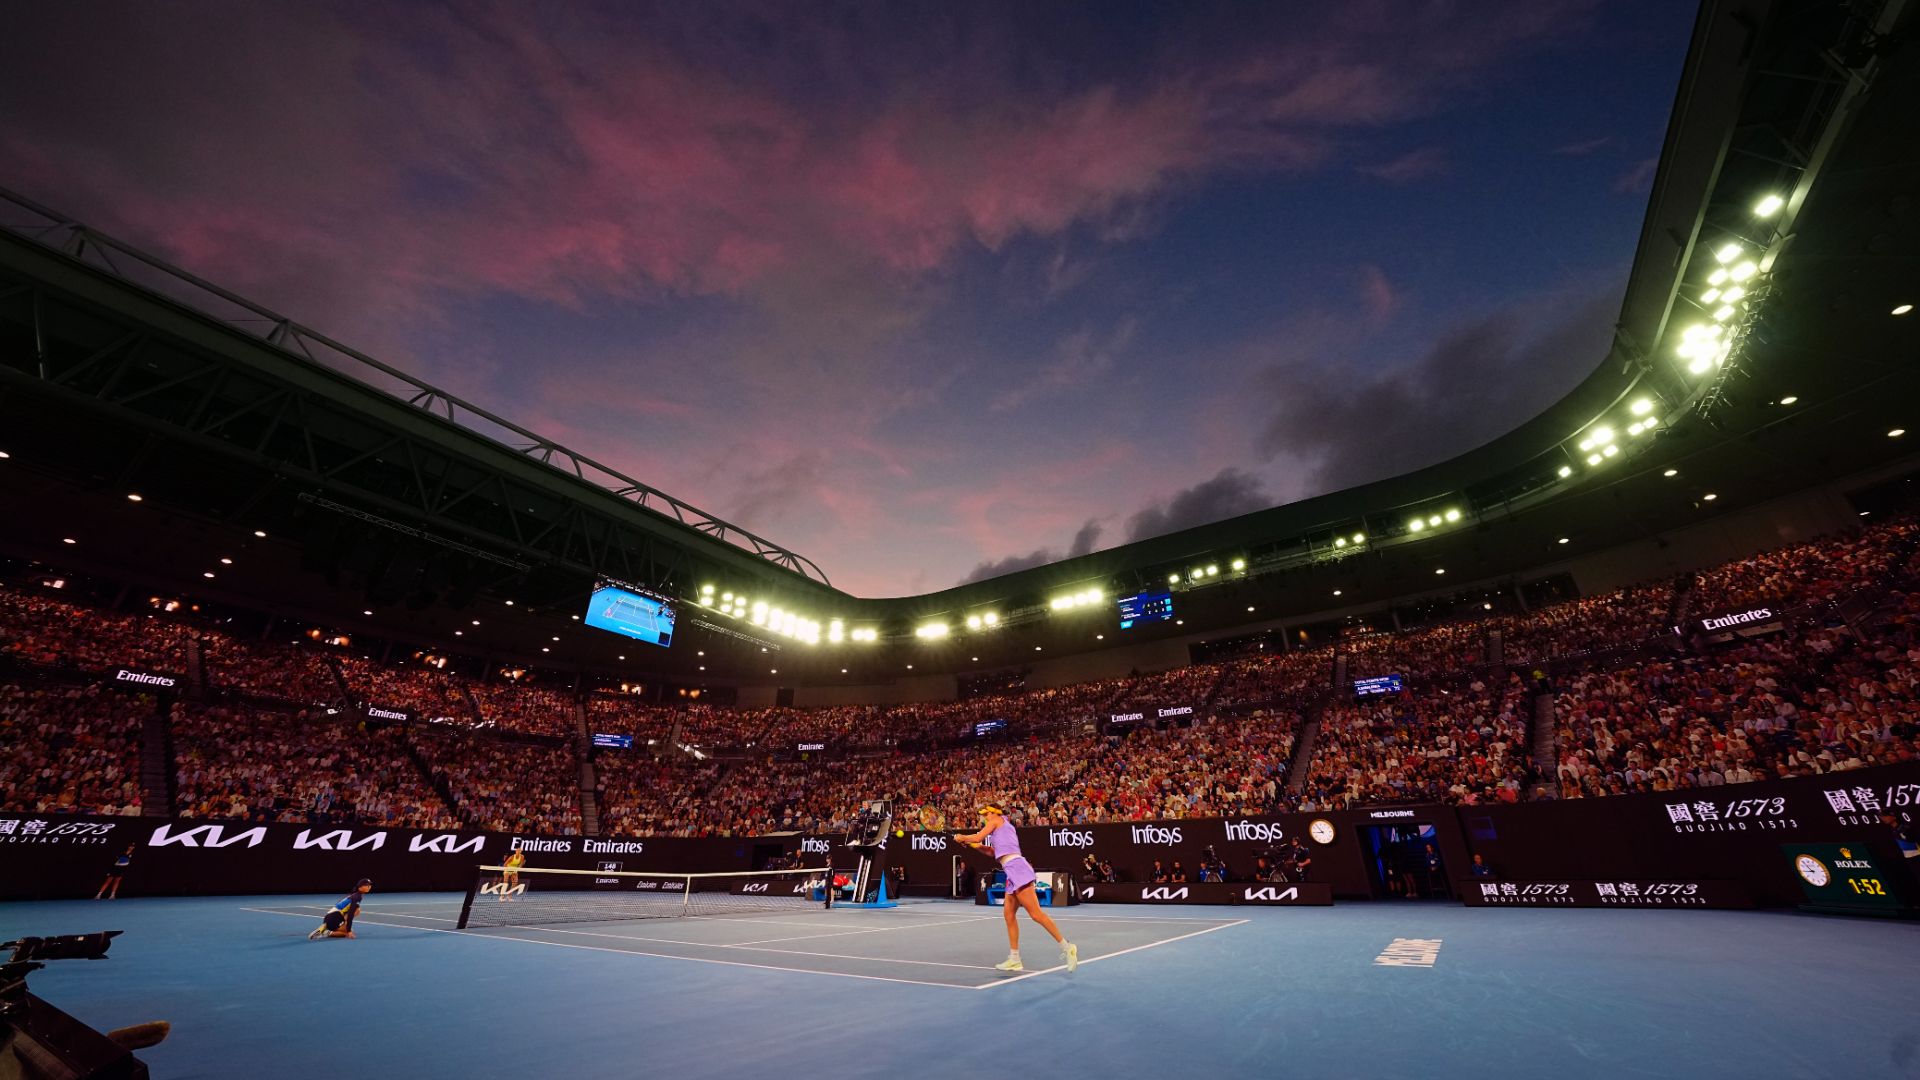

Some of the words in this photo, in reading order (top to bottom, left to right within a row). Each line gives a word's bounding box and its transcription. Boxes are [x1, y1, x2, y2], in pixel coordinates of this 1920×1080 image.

[1702, 608, 1772, 630] Emirates
[116, 669, 176, 687] Emirates
[368, 707, 407, 721] Emirates
[1111, 712, 1144, 723] Emirates
[1158, 706, 1193, 717] Emirates
[798, 743, 825, 751] Emirates
[1886, 784, 1920, 808] 157
[1370, 810, 1415, 818] MELBOURNE
[1665, 800, 1719, 824] 國窖
[1724, 797, 1786, 818] 1573
[1838, 812, 1911, 826] GUOJO
[46, 822, 116, 836] 1573
[1225, 819, 1283, 843] Infosys
[1675, 822, 1747, 833] GUOJIAO
[1758, 819, 1798, 829] 1573
[148, 823, 267, 848] KIA
[293, 828, 388, 851] KIA
[408, 833, 486, 854] KIA
[911, 833, 947, 852] Infosys
[1050, 828, 1094, 849] Infosys
[1131, 824, 1183, 847] Infosys
[510, 836, 572, 852] Emirates
[583, 838, 643, 853] Emirates
[801, 837, 830, 855] Infosys
[1834, 860, 1872, 868] ROLEX
[1142, 887, 1189, 900] KIA
[1245, 887, 1298, 900] KIA
[1521, 884, 1570, 895] 1573
[1644, 884, 1698, 895] 1573
[1848, 878, 1886, 895] 1:52
